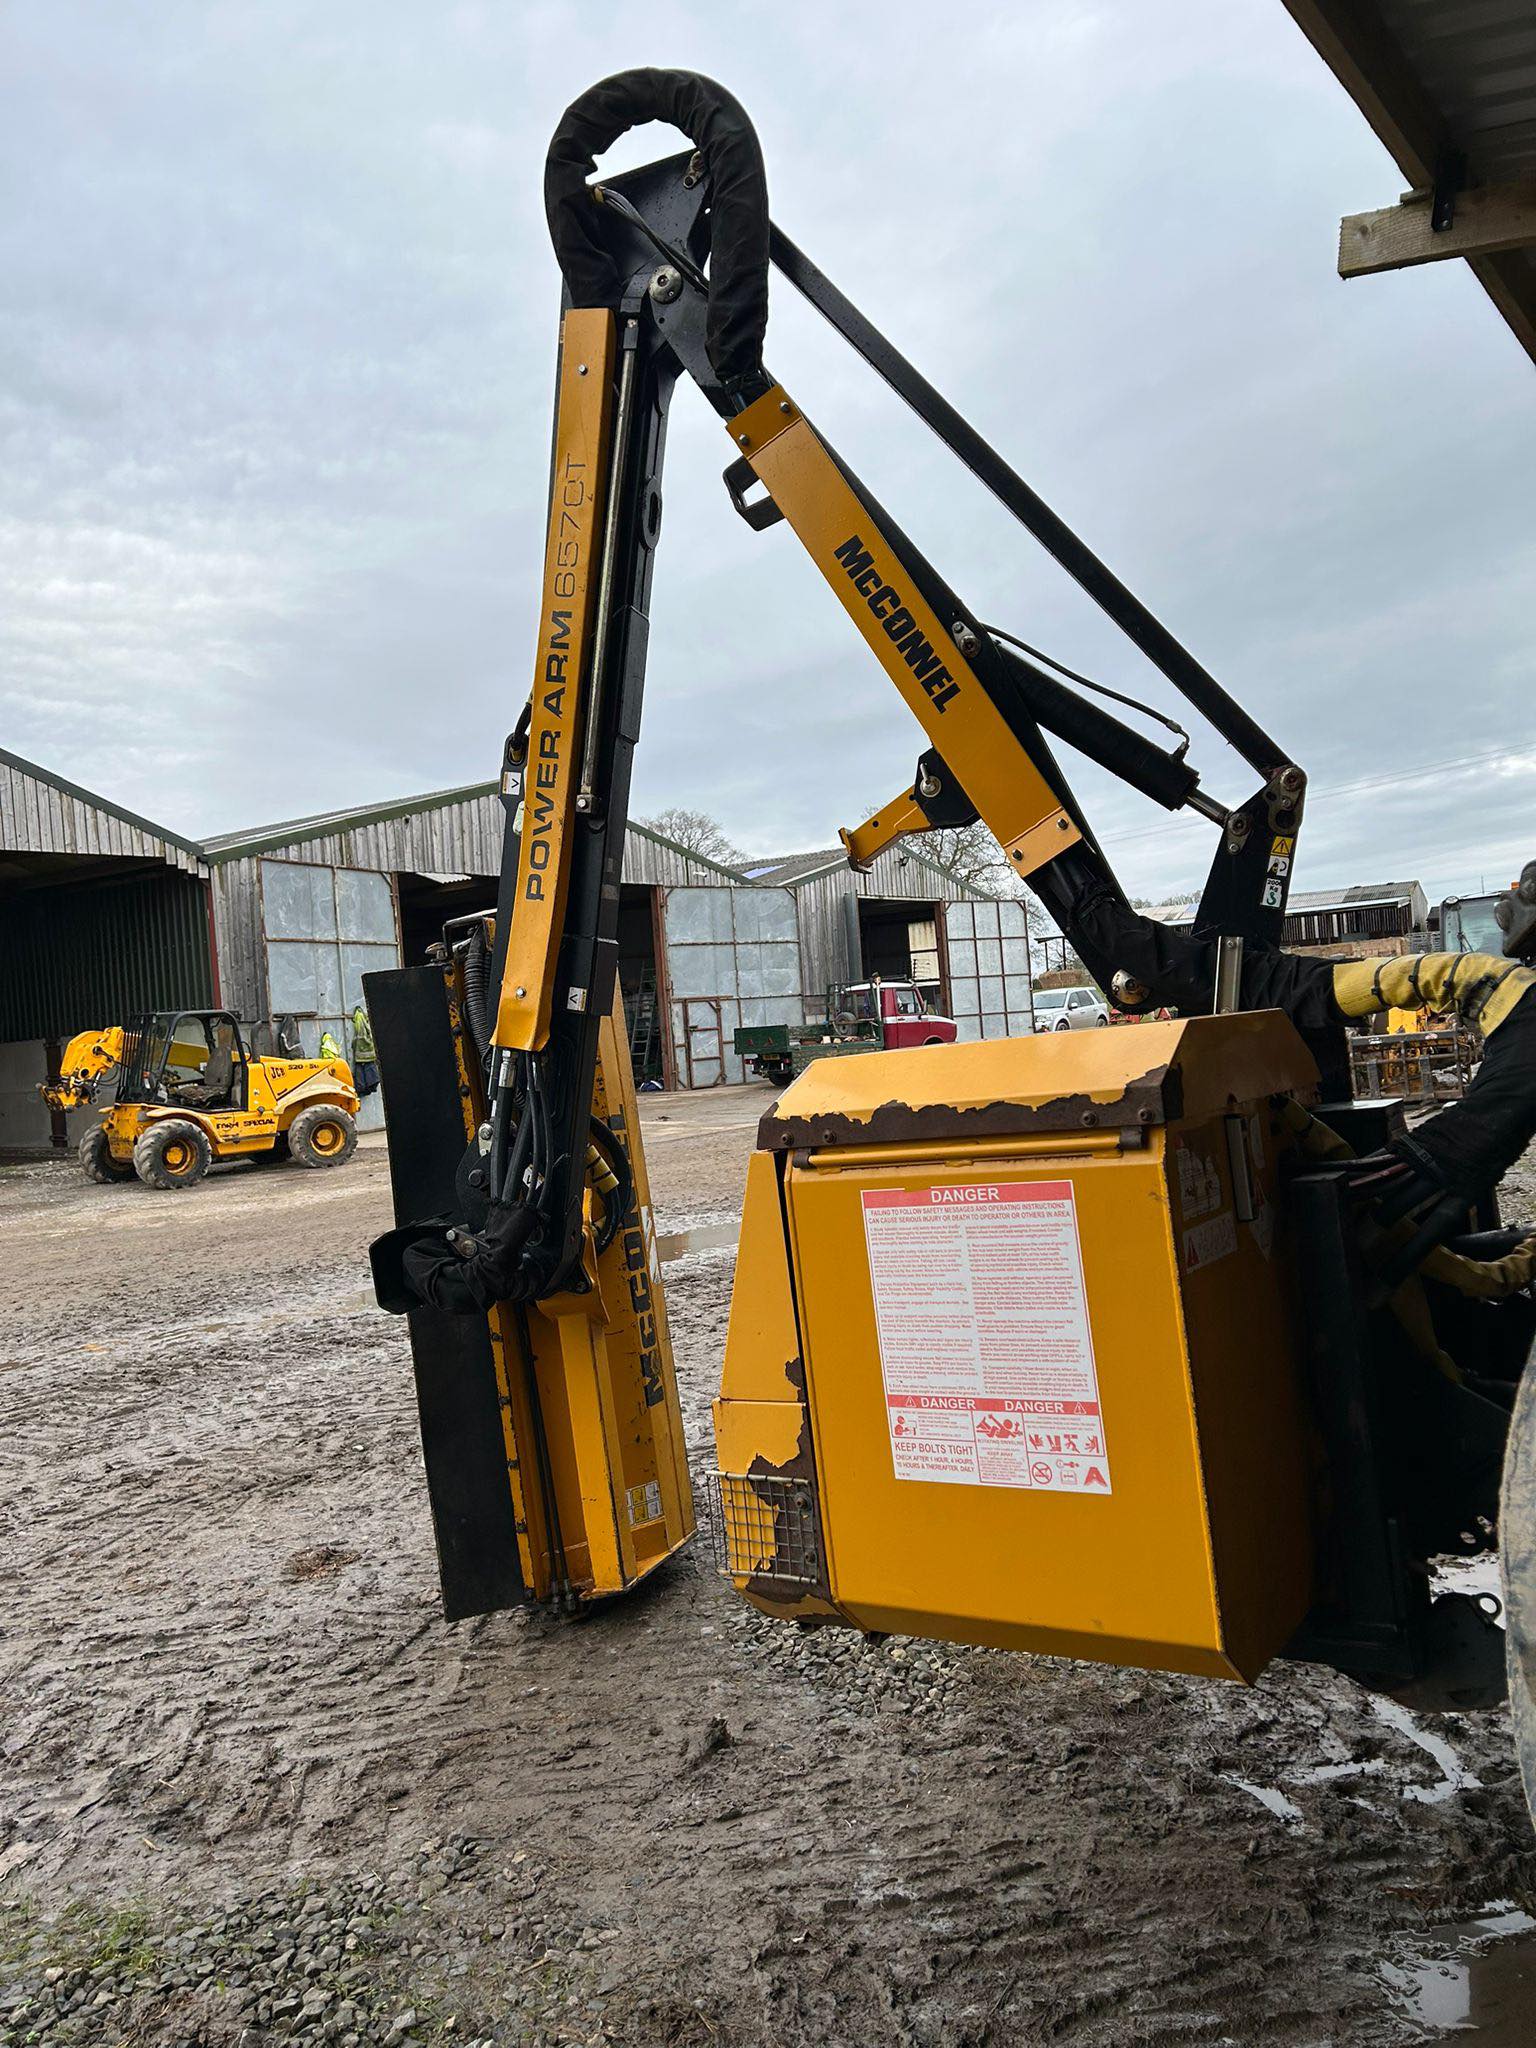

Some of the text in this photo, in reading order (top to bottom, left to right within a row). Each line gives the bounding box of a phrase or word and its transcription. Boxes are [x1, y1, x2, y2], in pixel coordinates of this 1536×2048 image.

[833, 534, 961, 715] McCONNEL
[525, 731, 561, 902] POWER
[543, 610, 573, 720] ARM
[270, 1066, 286, 1079] JCB
[243, 1118, 275, 1127] SPECIAL
[930, 1187, 1000, 1203] DANGER
[944, 1205, 975, 1213] MESSAGES
[988, 1204, 1020, 1212] OPERATING
[1021, 1202, 1066, 1211] INSTRUCTIONS
[951, 1213, 970, 1221] DEATH
[980, 1212, 1010, 1220] OPERATOR
[1011, 1211, 1020, 1219] OR
[1021, 1211, 1045, 1219] OTHERS
[920, 1397, 1065, 1413] DANGER DANGER
[895, 1442, 973, 1456] KEEP BOLTS TIGHT
